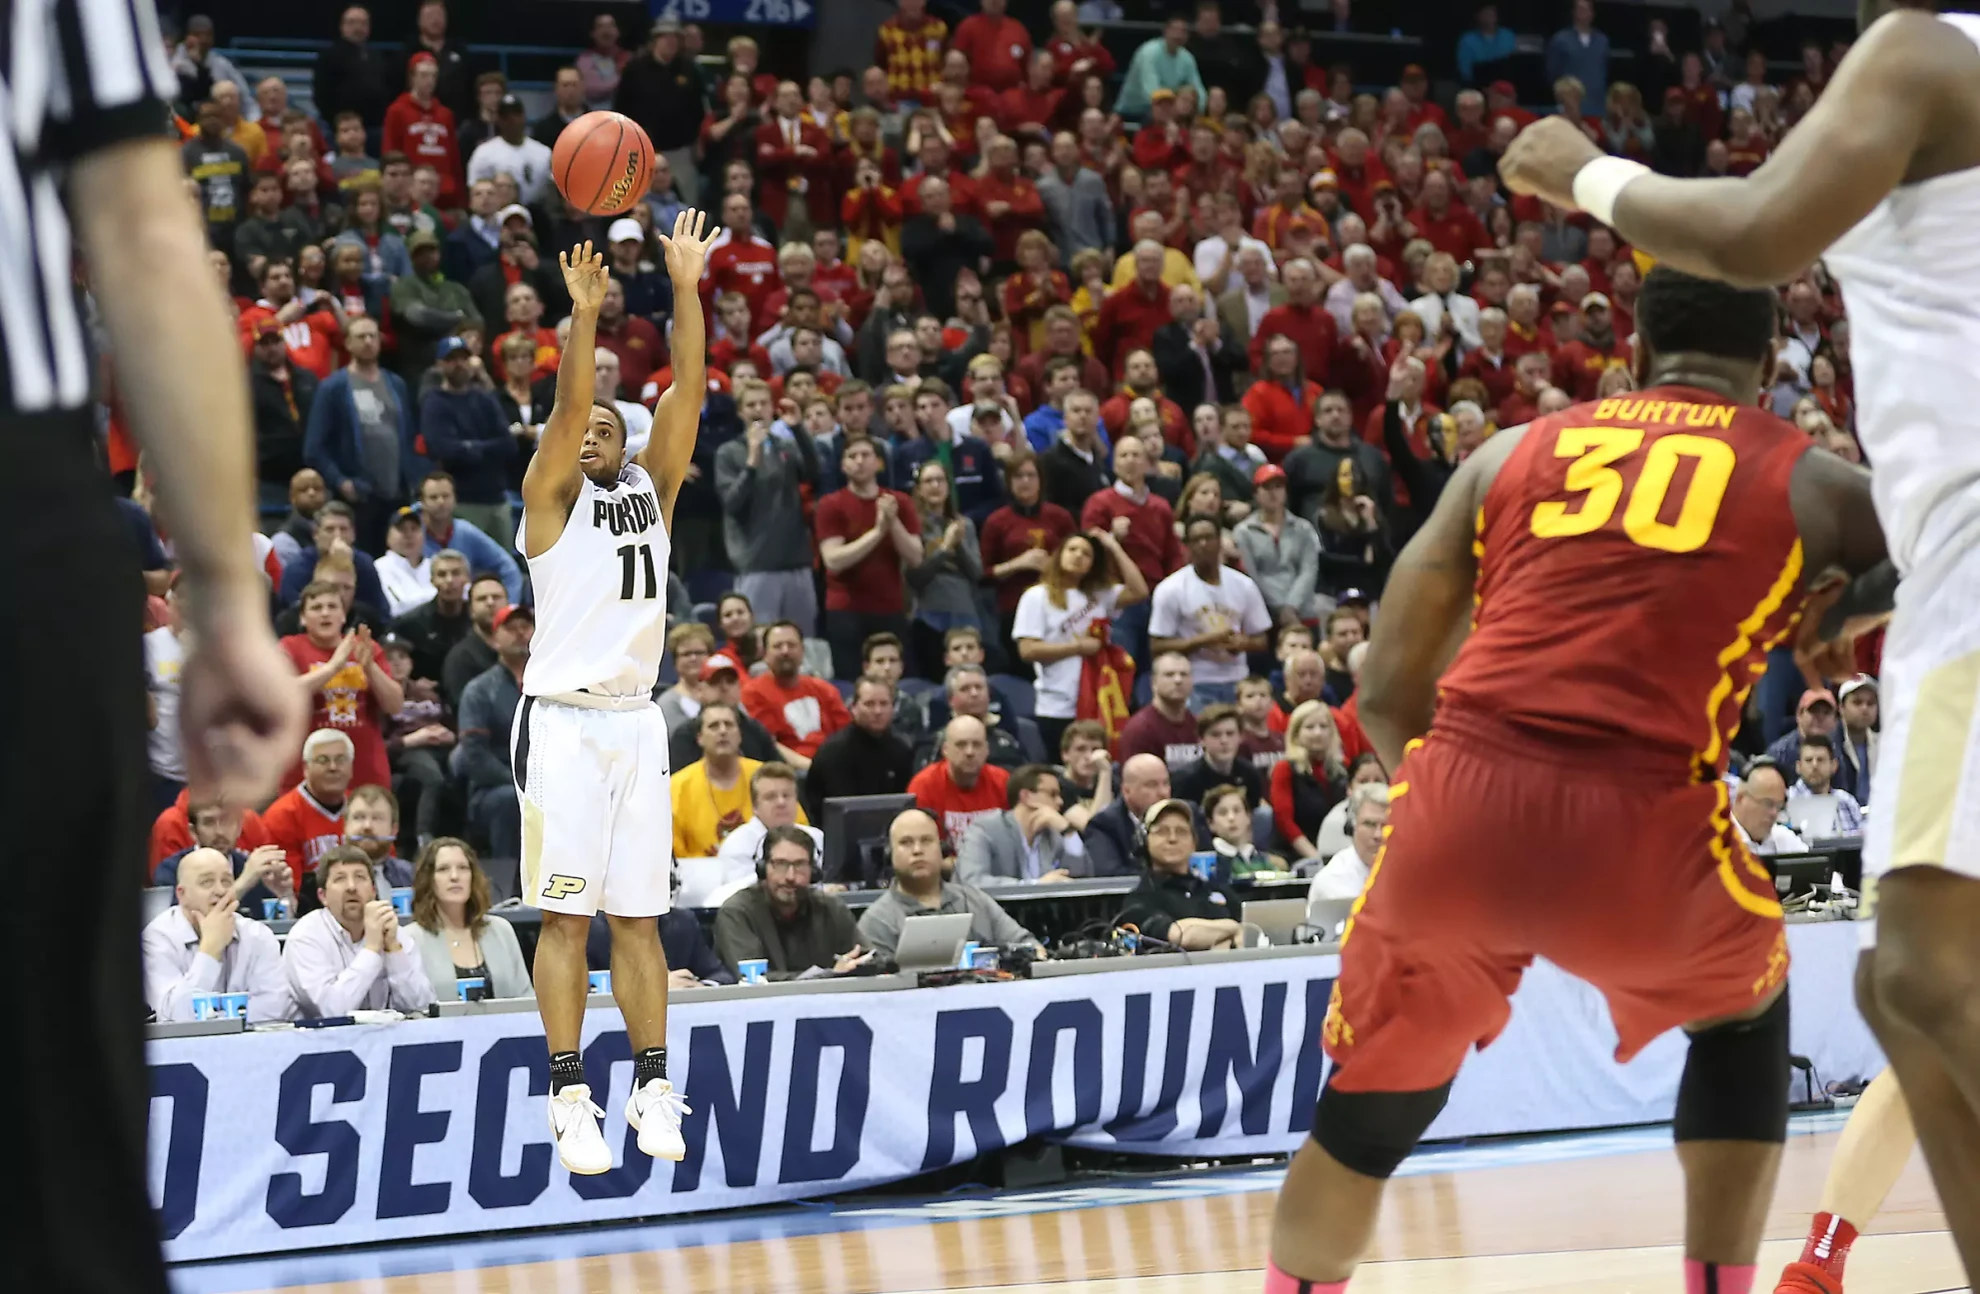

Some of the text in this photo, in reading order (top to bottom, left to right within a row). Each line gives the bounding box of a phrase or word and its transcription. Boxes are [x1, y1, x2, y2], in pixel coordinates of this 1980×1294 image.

[744, 0, 791, 23] 216
[600, 149, 639, 210] Wilson
[1593, 398, 1738, 429] BURTON
[593, 491, 660, 537] PURDU
[1530, 426, 1737, 553] 30
[617, 543, 657, 600] 11
[542, 873, 587, 900] P
[265, 1015, 874, 1230] SECOND
